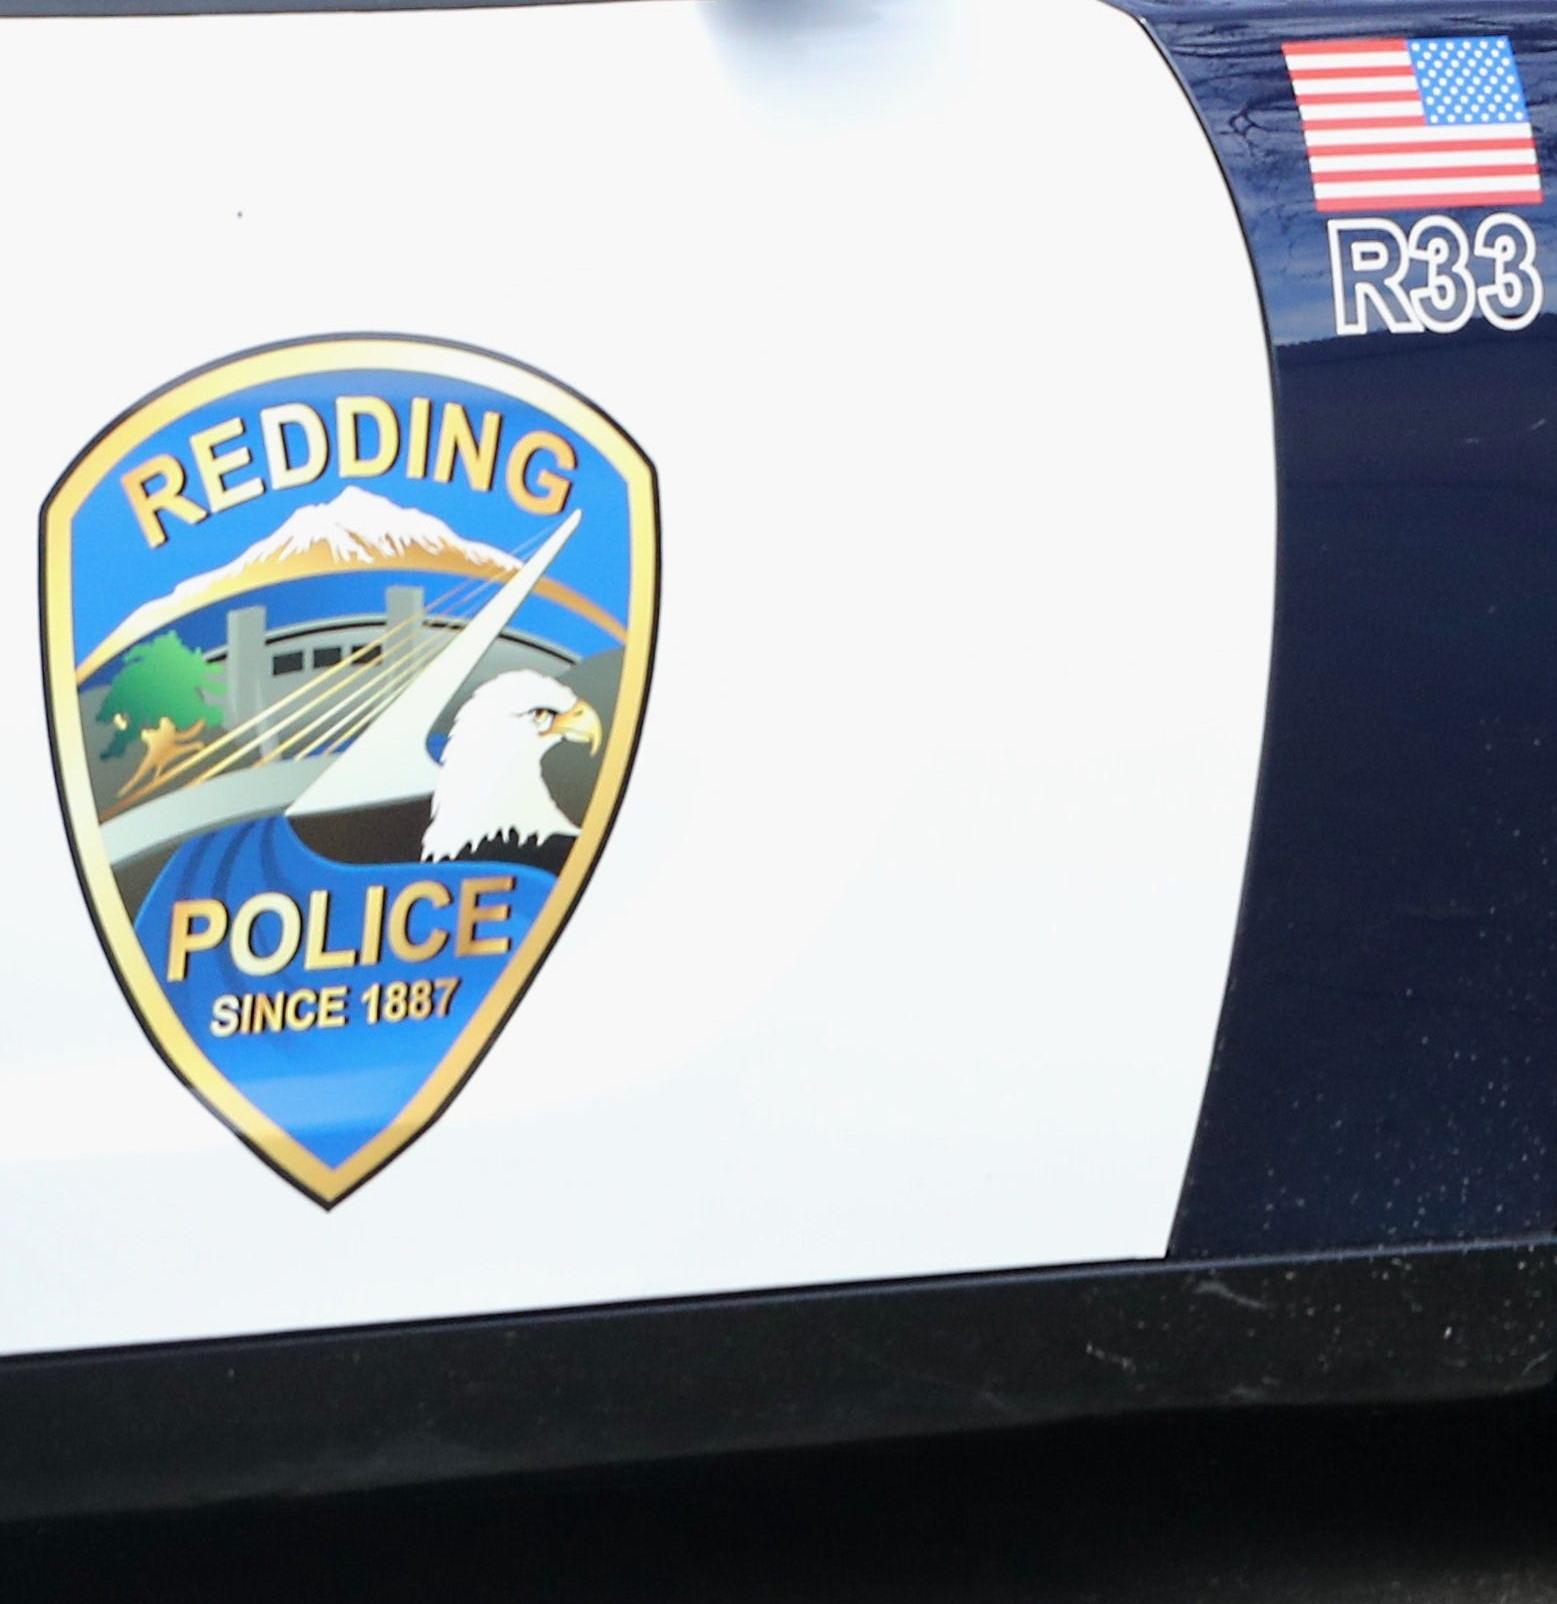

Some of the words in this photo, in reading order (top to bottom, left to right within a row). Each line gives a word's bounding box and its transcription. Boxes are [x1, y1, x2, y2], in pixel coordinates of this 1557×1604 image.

[1327, 212, 1544, 335] R33
[120, 395, 579, 549] REDDING
[165, 875, 516, 983] POLICE
[210, 984, 350, 1039] SINCE
[358, 977, 464, 1025] 1887
